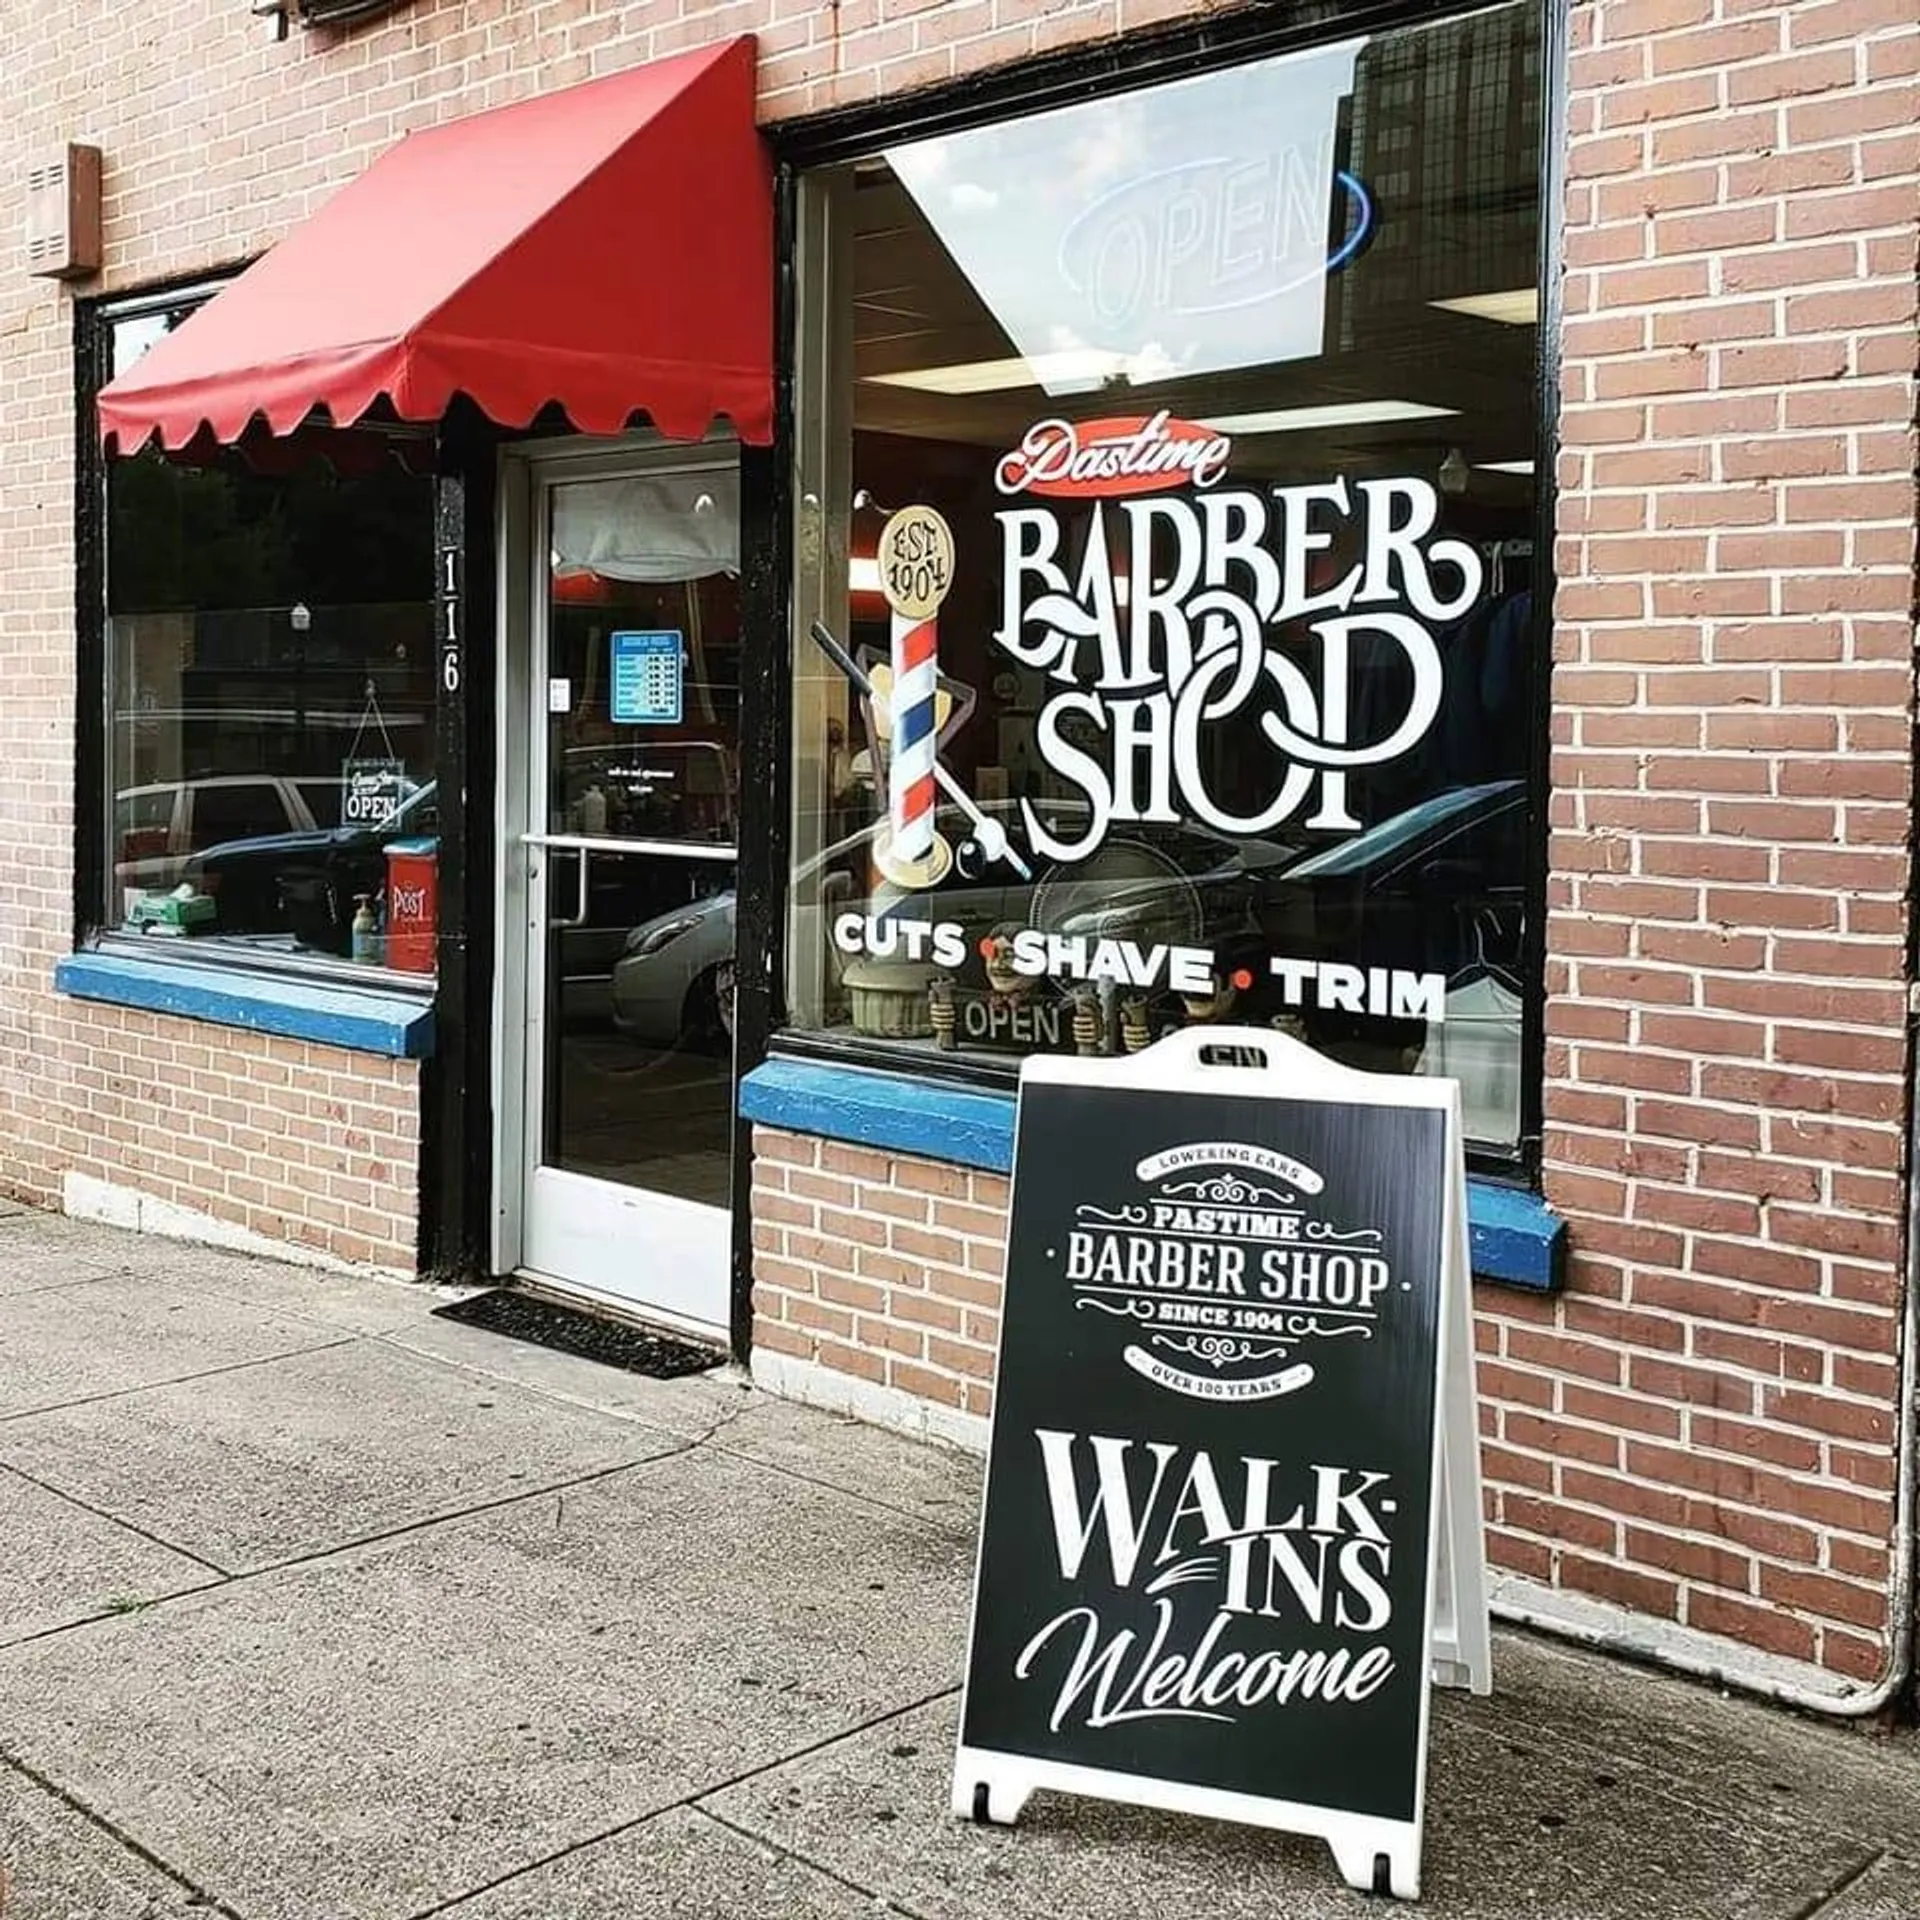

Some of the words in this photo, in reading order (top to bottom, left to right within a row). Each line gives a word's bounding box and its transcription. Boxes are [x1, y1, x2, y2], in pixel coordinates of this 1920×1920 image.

[1090, 131, 1335, 331] OPEN
[995, 409, 1232, 495] Pastime
[888, 557, 945, 601] 1904
[993, 475, 1482, 718] BARBER
[1022, 612, 1443, 863] SHOP
[348, 796, 396, 819] OPEN
[834, 911, 967, 968] CUTS
[1011, 929, 1215, 995] SHAVE
[1269, 956, 1446, 1022] TRIM
[965, 1002, 1060, 1044] OPEN
[1158, 1147, 1250, 1168] LOWERING
[1255, 1154, 1302, 1180] EARS
[1153, 1205, 1299, 1240] PASTIME
[1065, 1231, 1247, 1296] BARBER
[1260, 1249, 1390, 1308] SHOP
[1158, 1301, 1229, 1326] SINCE
[1232, 1308, 1284, 1332] 1904
[1151, 1364, 1192, 1390] OVER
[1197, 1381, 1223, 1395] 100
[1227, 1378, 1282, 1396] YEARS
[1218, 1532, 1393, 1632] INS
[1014, 1597, 1397, 1733] Welcome
